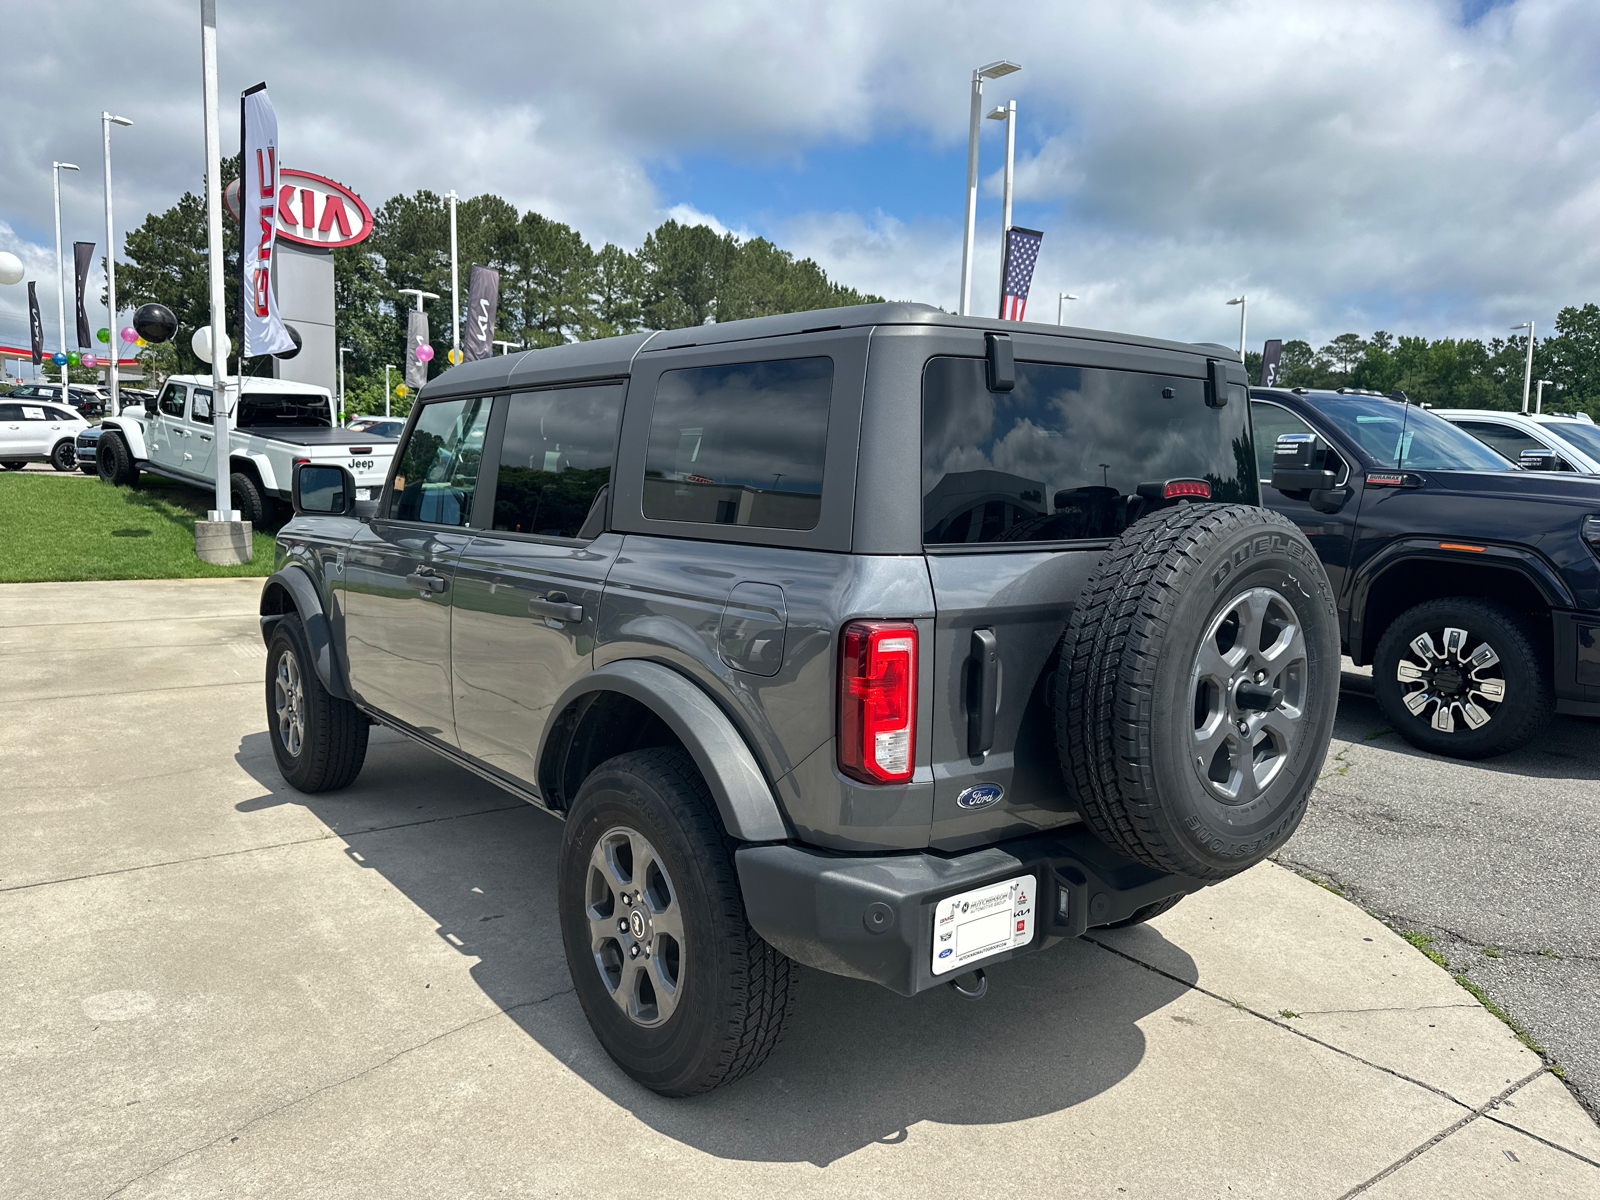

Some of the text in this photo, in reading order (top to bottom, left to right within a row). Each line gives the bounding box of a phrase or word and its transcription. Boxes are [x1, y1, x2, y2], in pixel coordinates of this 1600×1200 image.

[254, 147, 274, 317] GMC
[348, 458, 374, 470] Jeep
[1211, 535, 1317, 592] DUELER
[969, 790, 995, 805] Ford
[940, 914, 954, 924] GMC
